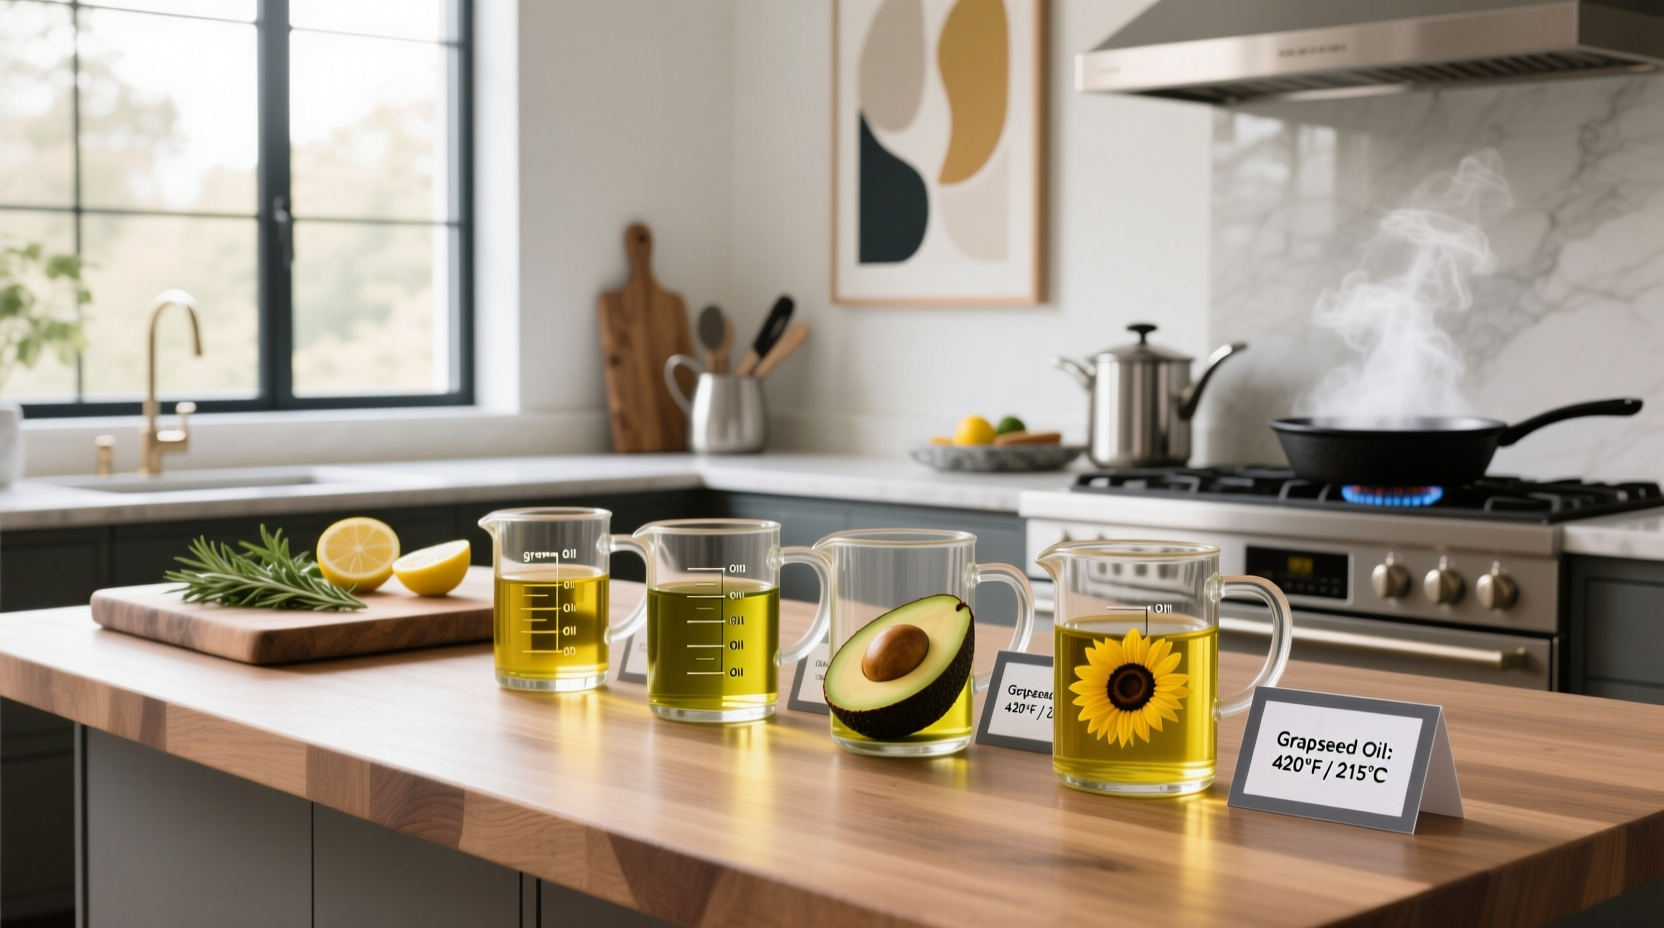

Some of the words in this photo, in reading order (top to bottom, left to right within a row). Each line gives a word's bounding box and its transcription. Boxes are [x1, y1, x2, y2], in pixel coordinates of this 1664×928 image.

[1277, 730, 1358, 755] Grapseed
[1362, 740, 1393, 761] Oil:
[1271, 754, 1324, 775] 420°F
[1322, 760, 1334, 781] /
[1335, 761, 1388, 784] 215°C
